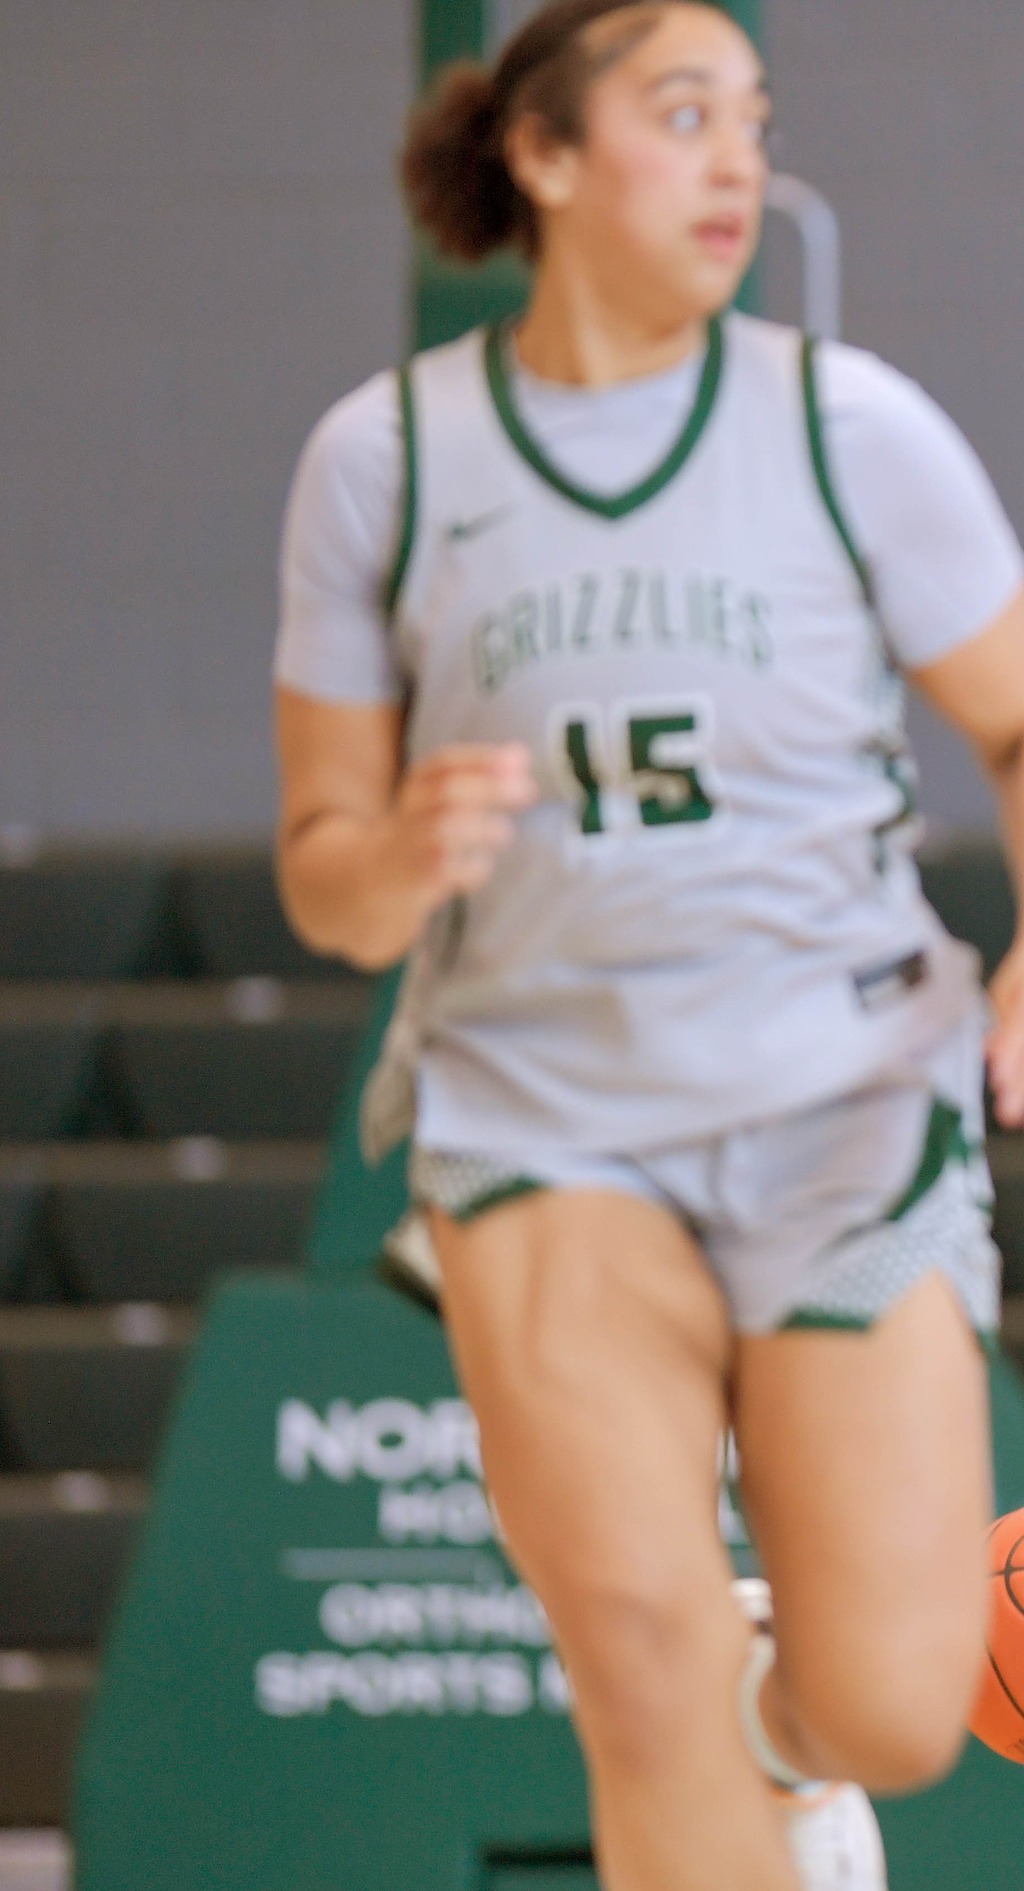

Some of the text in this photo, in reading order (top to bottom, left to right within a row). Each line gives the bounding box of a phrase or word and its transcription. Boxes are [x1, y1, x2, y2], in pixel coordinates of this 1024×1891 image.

[471, 566, 775, 692] GRIZZLIES
[558, 706, 720, 840] 15
[277, 1398, 483, 1481] NOR
[256, 1650, 533, 1717] SPORTS
